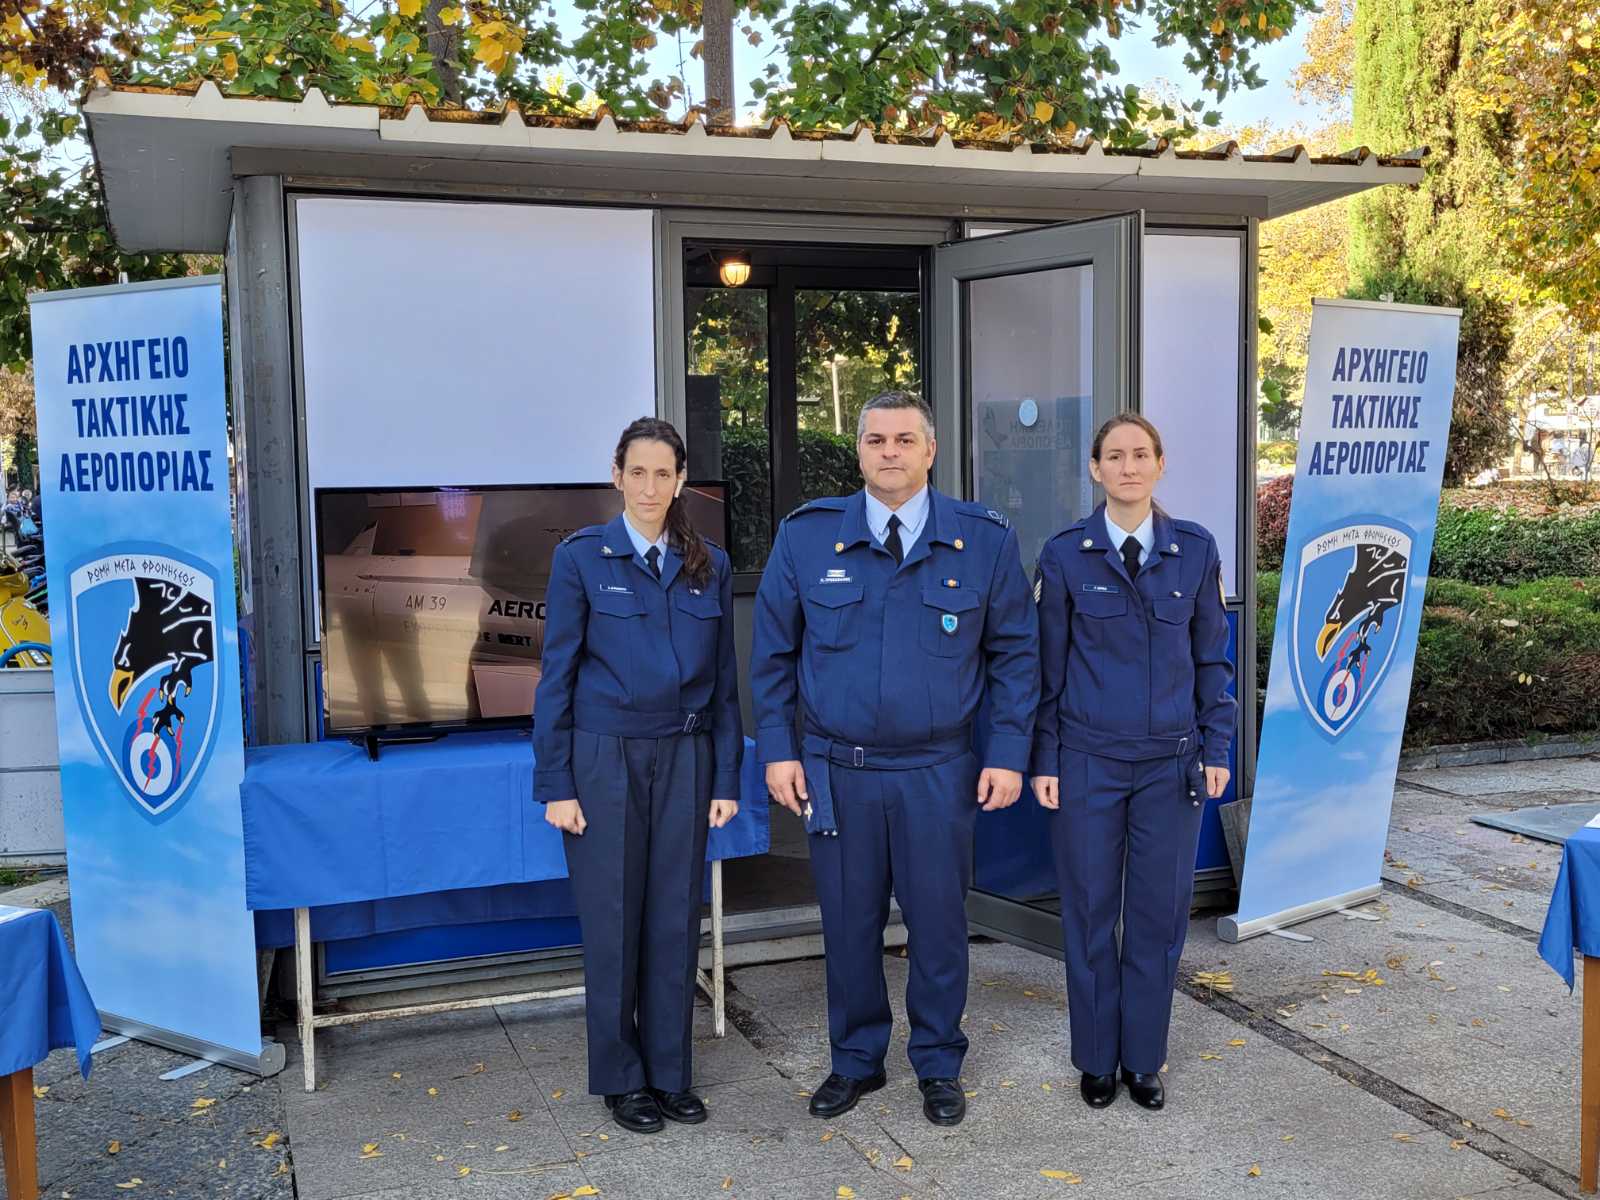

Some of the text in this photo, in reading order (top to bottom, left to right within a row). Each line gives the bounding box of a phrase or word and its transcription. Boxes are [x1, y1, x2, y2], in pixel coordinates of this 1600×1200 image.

[67, 336, 189, 384] ΑΡΧΗΓΕΙΟ
[1332, 347, 1428, 384] ΑΡΧΗΓΕΙΟ
[72, 393, 190, 438] ΤΑΚΤΙΚΗΣ
[1331, 395, 1422, 429] ΤΑΚΤΙΚΗΣ
[59, 450, 214, 491] ΑΕΡΟΠΟΡΙΑΣ
[1308, 440, 1430, 476] ΑΕΡΟΠΟΡΙΑΣ
[405, 595, 447, 611] AM 39
